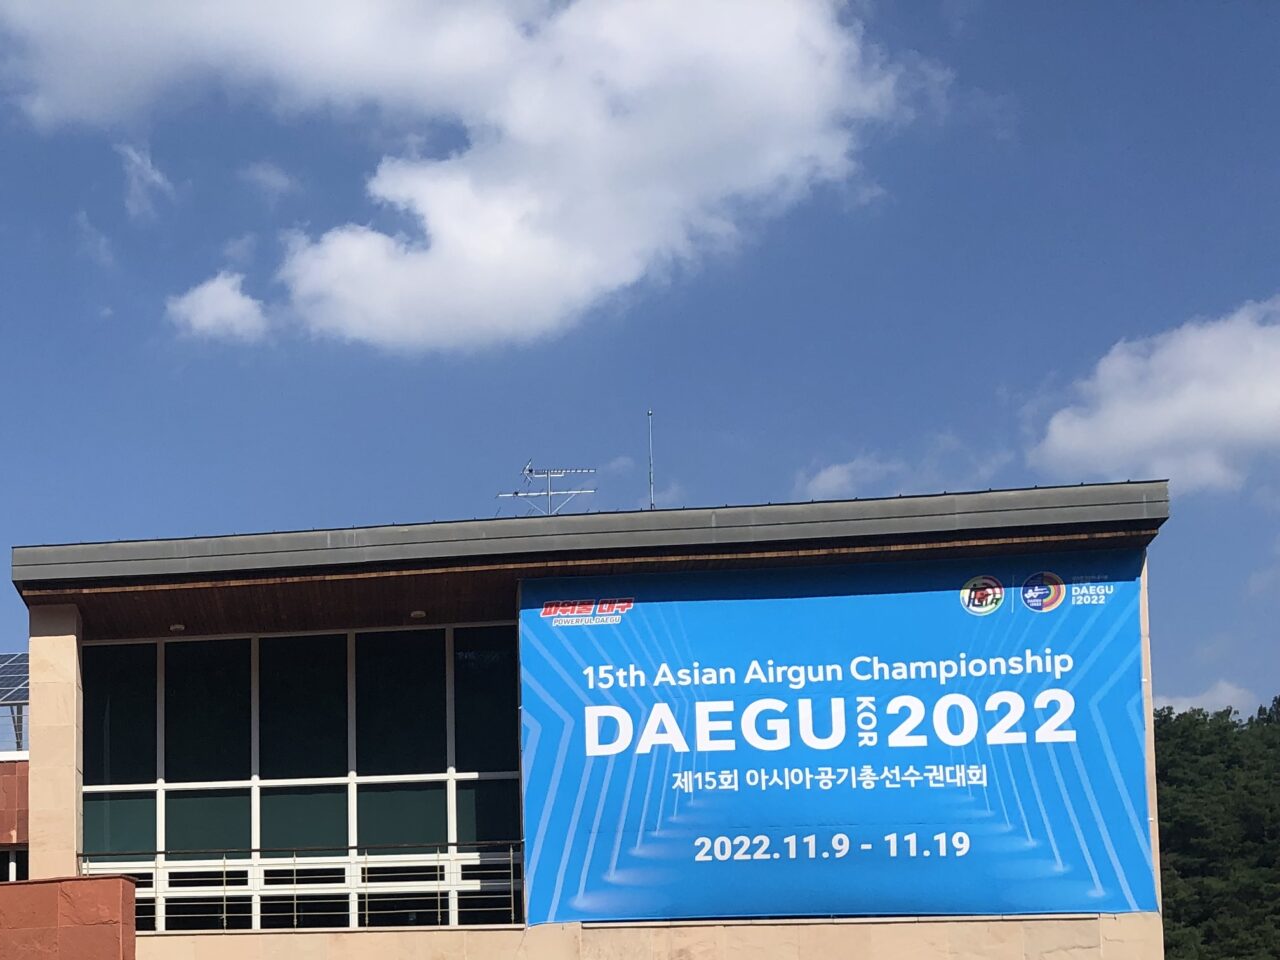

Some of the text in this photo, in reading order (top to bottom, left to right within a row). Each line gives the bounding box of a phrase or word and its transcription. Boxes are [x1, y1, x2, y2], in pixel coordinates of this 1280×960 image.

[596, 597, 634, 614] 대구
[1072, 585, 1113, 596] DAEGU
[1076, 595, 1105, 605] 2022
[553, 616, 621, 626] POWERFUL DAEGU
[582, 647, 1074, 689] 15th Asian Airgun Championship
[585, 688, 1077, 757] DAEGU 2022
[857, 696, 878, 748] KOR
[672, 763, 988, 794] 제15회 아시아공기총선수권대회
[694, 832, 849, 862] 2022.11.9
[884, 831, 971, 859] 11.19
